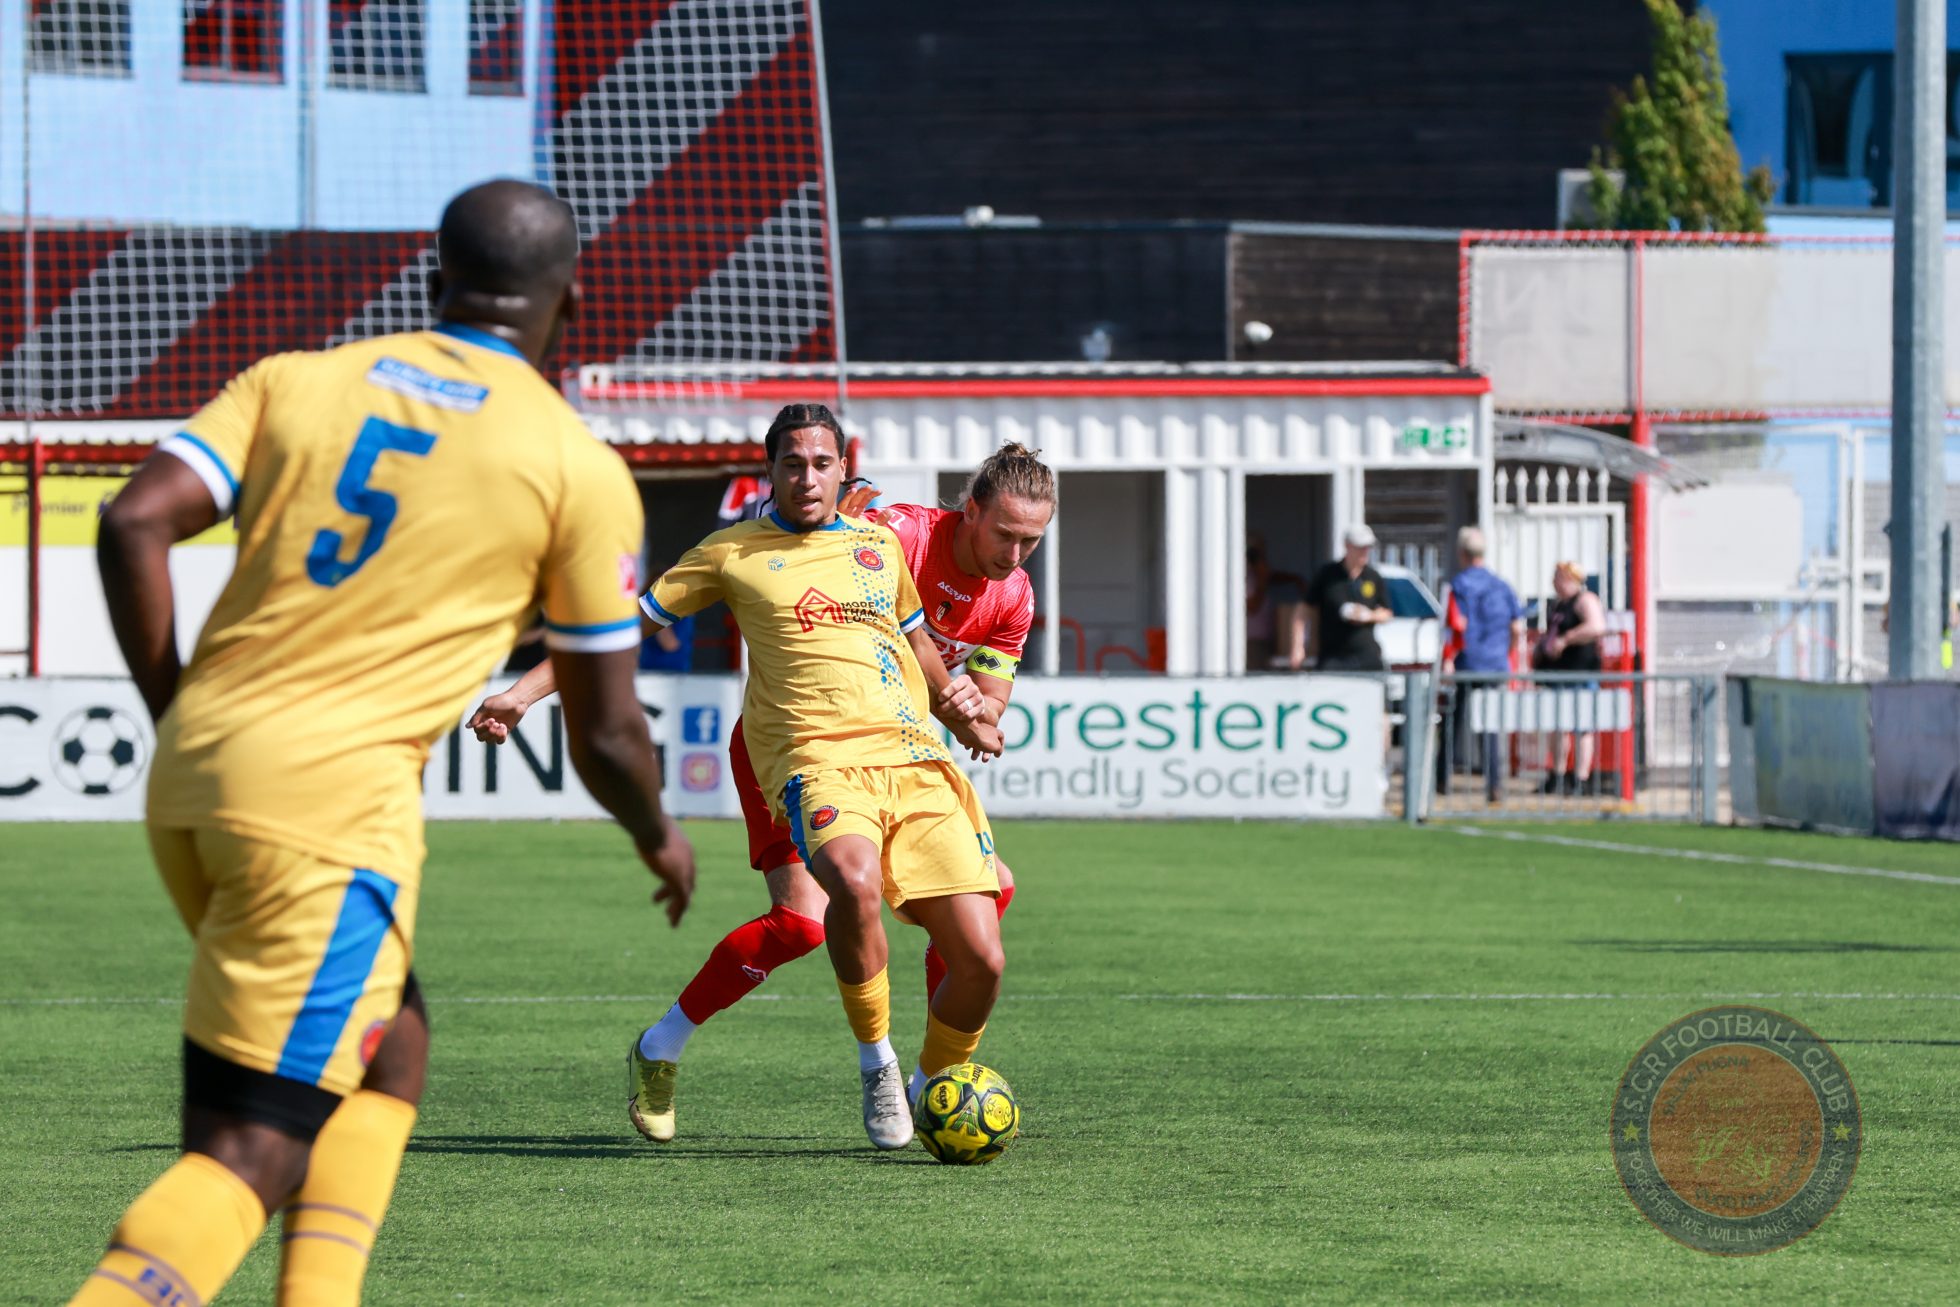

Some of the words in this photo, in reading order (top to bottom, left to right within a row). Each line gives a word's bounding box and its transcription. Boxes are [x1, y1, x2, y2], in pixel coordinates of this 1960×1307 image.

[306, 415, 438, 587] 5
[842, 608, 877, 618] THAN
[946, 690, 1348, 751] oresters
[966, 757, 1143, 809] riendly
[1161, 758, 1350, 809] Society
